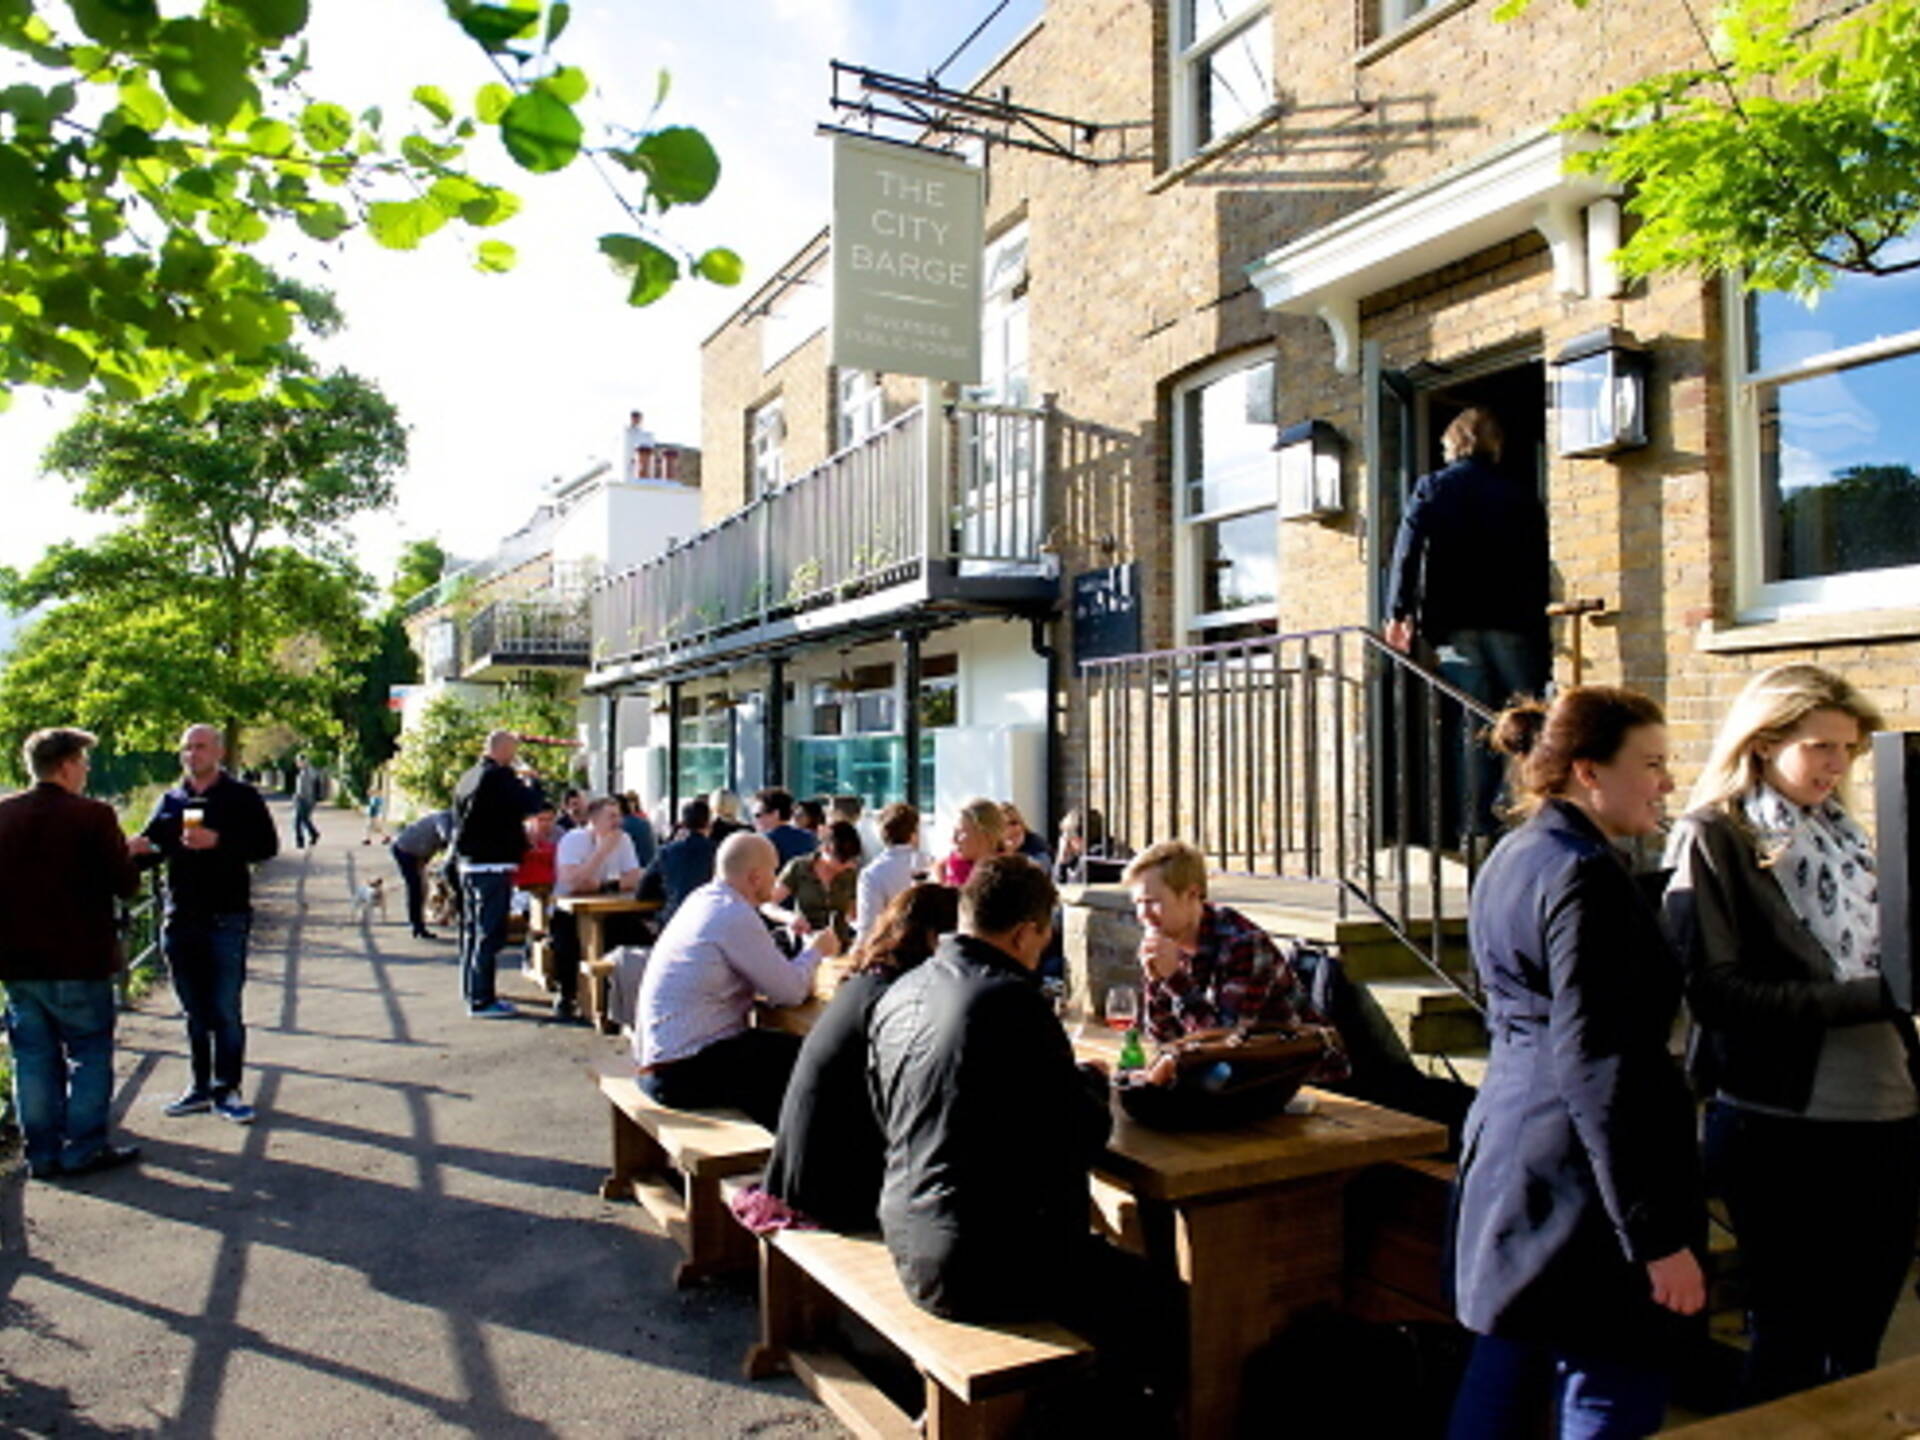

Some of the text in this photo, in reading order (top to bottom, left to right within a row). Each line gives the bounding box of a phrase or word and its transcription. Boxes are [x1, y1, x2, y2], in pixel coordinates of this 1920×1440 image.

[876, 170, 945, 207] THE
[871, 208, 950, 246] CITY
[851, 244, 969, 289] BARGE
